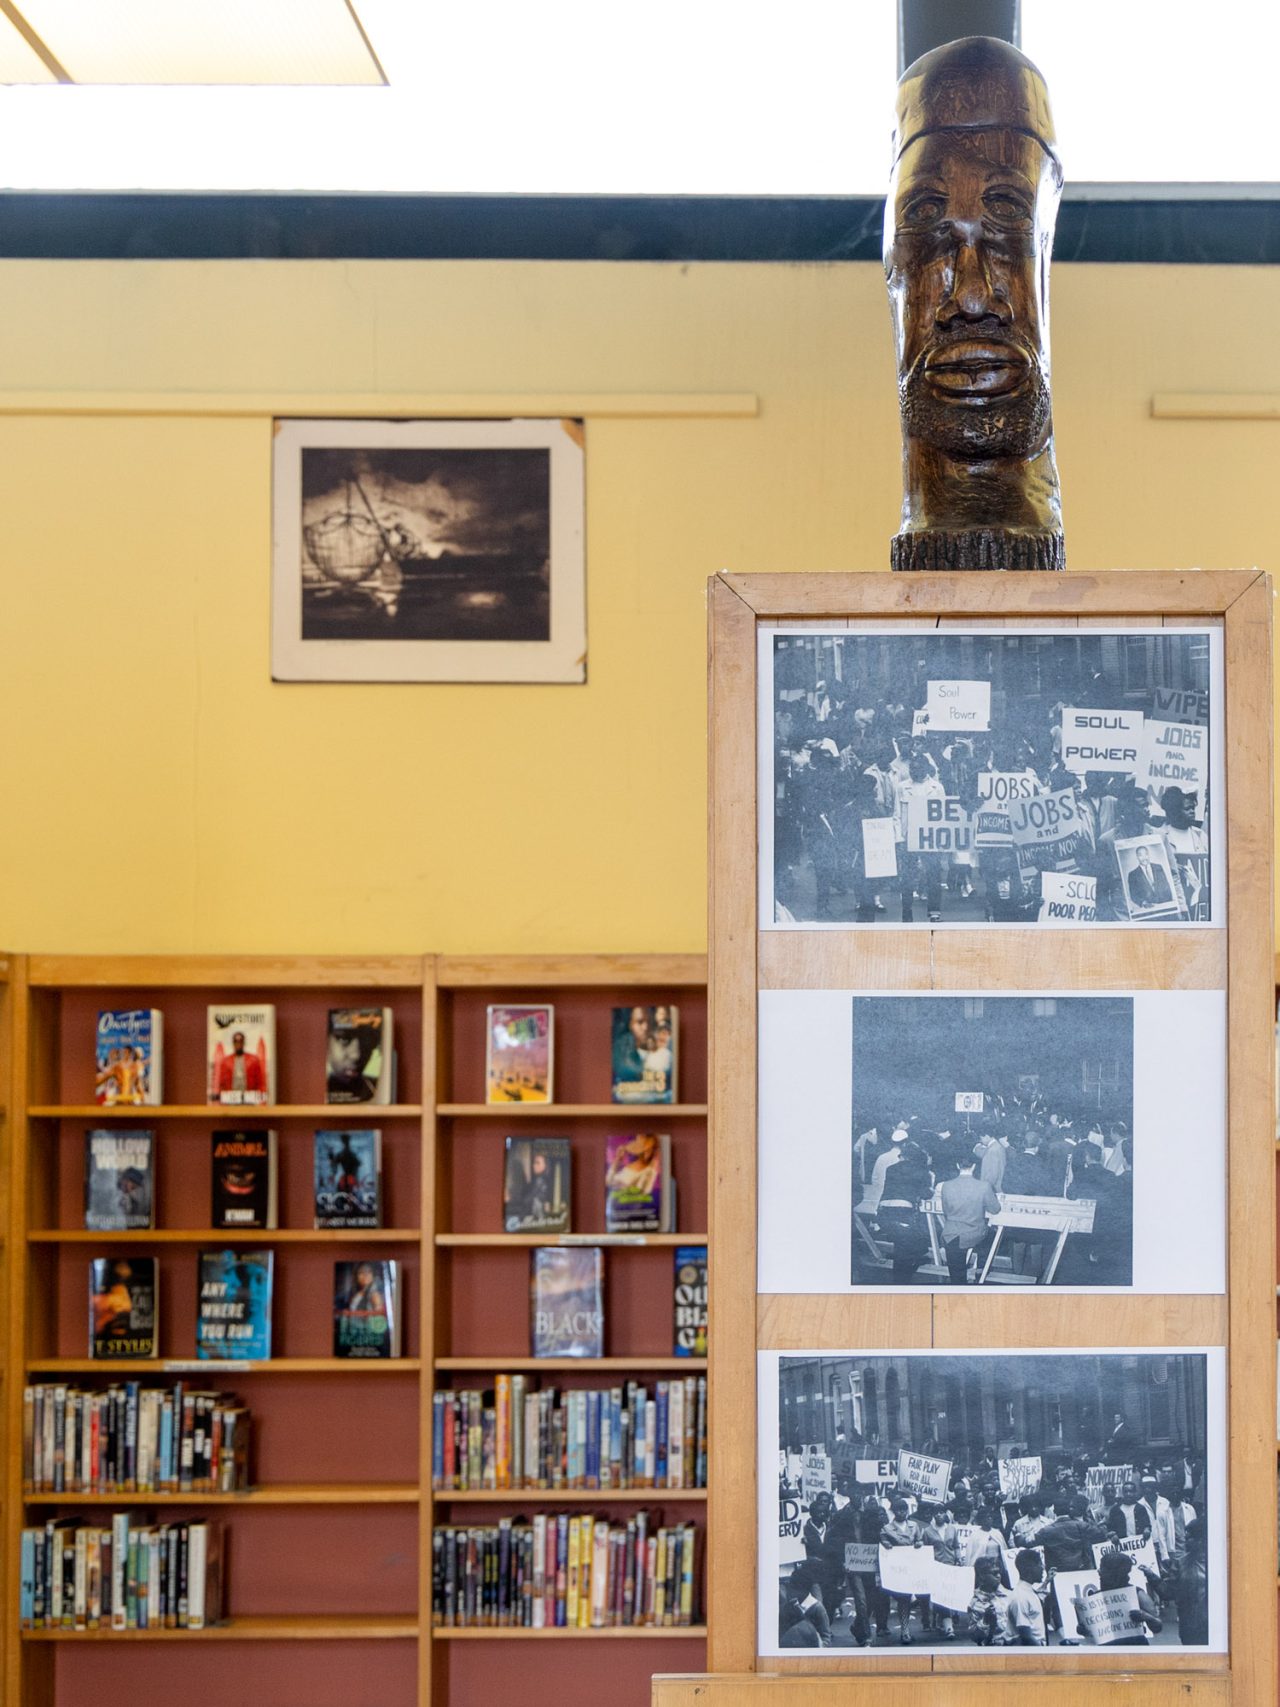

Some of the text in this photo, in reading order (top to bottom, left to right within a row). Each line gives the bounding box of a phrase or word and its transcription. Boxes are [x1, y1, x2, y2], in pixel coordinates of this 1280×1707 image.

[938, 685, 960, 698] Soul
[949, 706, 977, 720] Power
[1075, 716, 1130, 729] SOUL
[1156, 727, 1202, 749] JOBS
[1066, 746, 1137, 761] POWER
[1165, 751, 1185, 761] AND
[981, 777, 1031, 800] JOBS
[1013, 795, 1074, 831] JOBS
[979, 816, 1009, 830] INCOME
[1036, 826, 1059, 838] and
[1049, 902, 1074, 918] POOR
[201, 1282, 227, 1297] ANY
[201, 1303, 245, 1318] WHERE
[536, 1311, 600, 1335] BLACK
[201, 1324, 254, 1338] YOU RUN
[908, 1457, 940, 1475] FAIR PLAY
[909, 1472, 930, 1486] FOR ALL
[903, 1480, 939, 1496] AMERICANS
